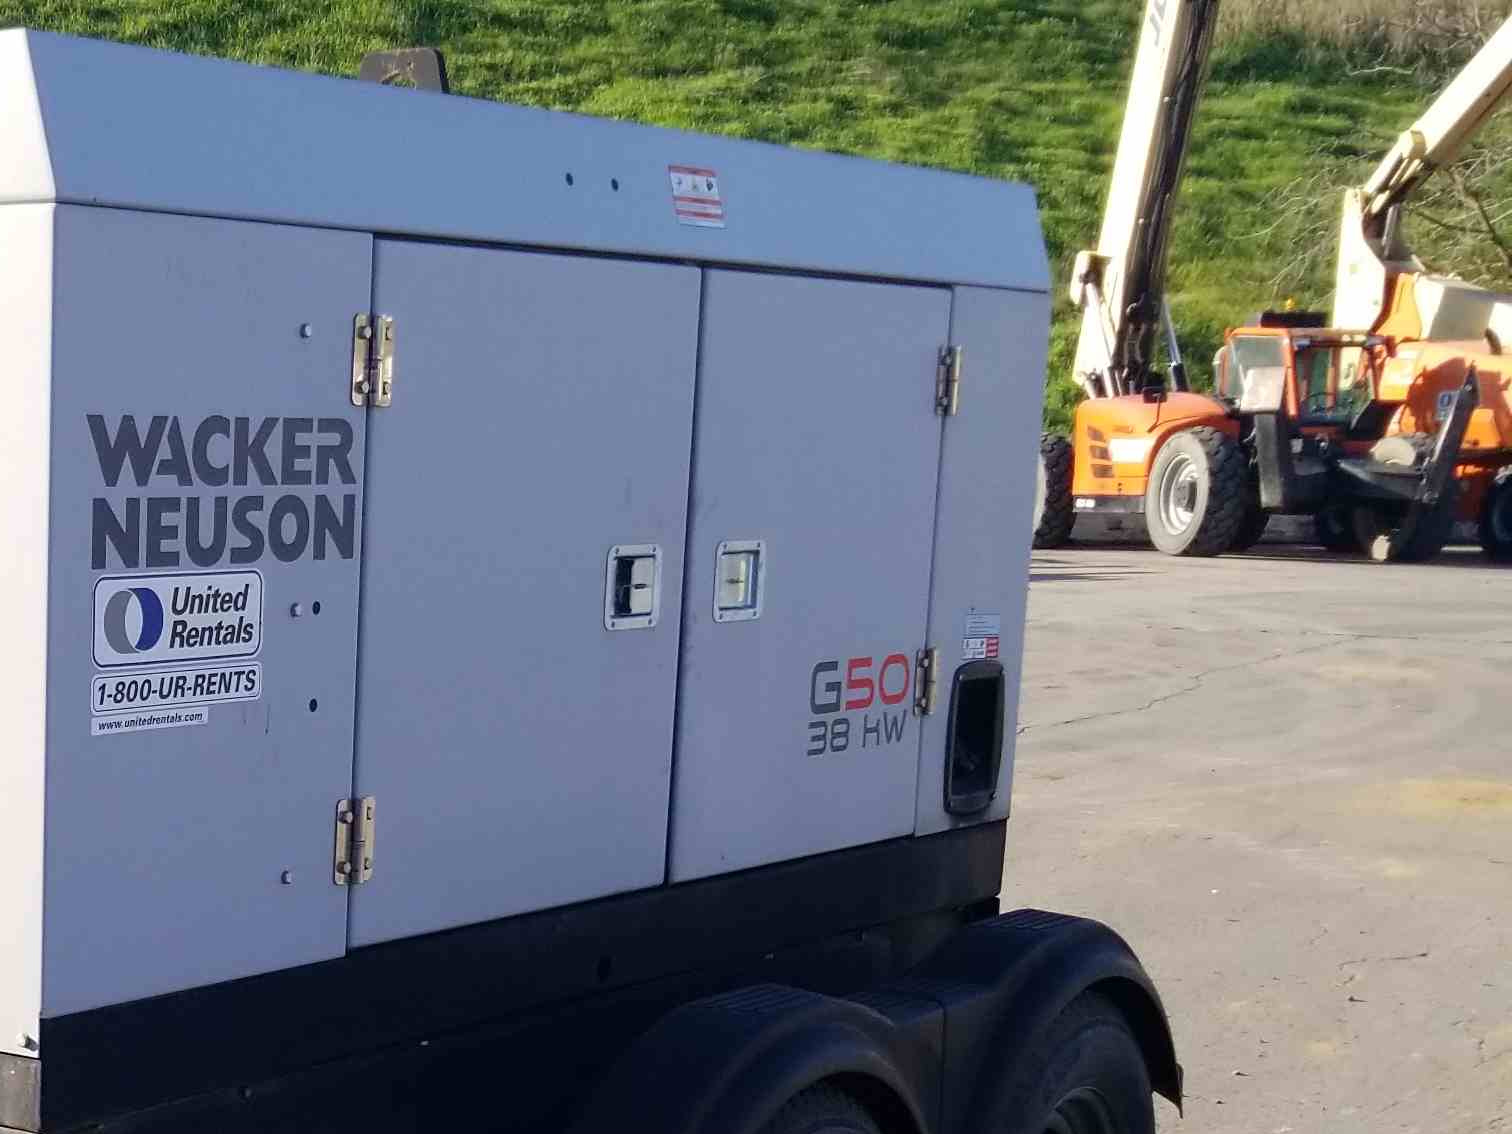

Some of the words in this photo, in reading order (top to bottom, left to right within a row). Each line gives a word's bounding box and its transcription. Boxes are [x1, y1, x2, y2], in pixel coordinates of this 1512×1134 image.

[85, 414, 357, 487] WACKER
[91, 494, 357, 569] NEUSON
[171, 583, 250, 616] United
[169, 616, 254, 649] Rentals
[97, 669, 257, 706] 1-800-UR-RENTS
[810, 653, 910, 715] G50
[98, 711, 204, 731] www.unitedrentals.com
[807, 718, 850, 756] 38
